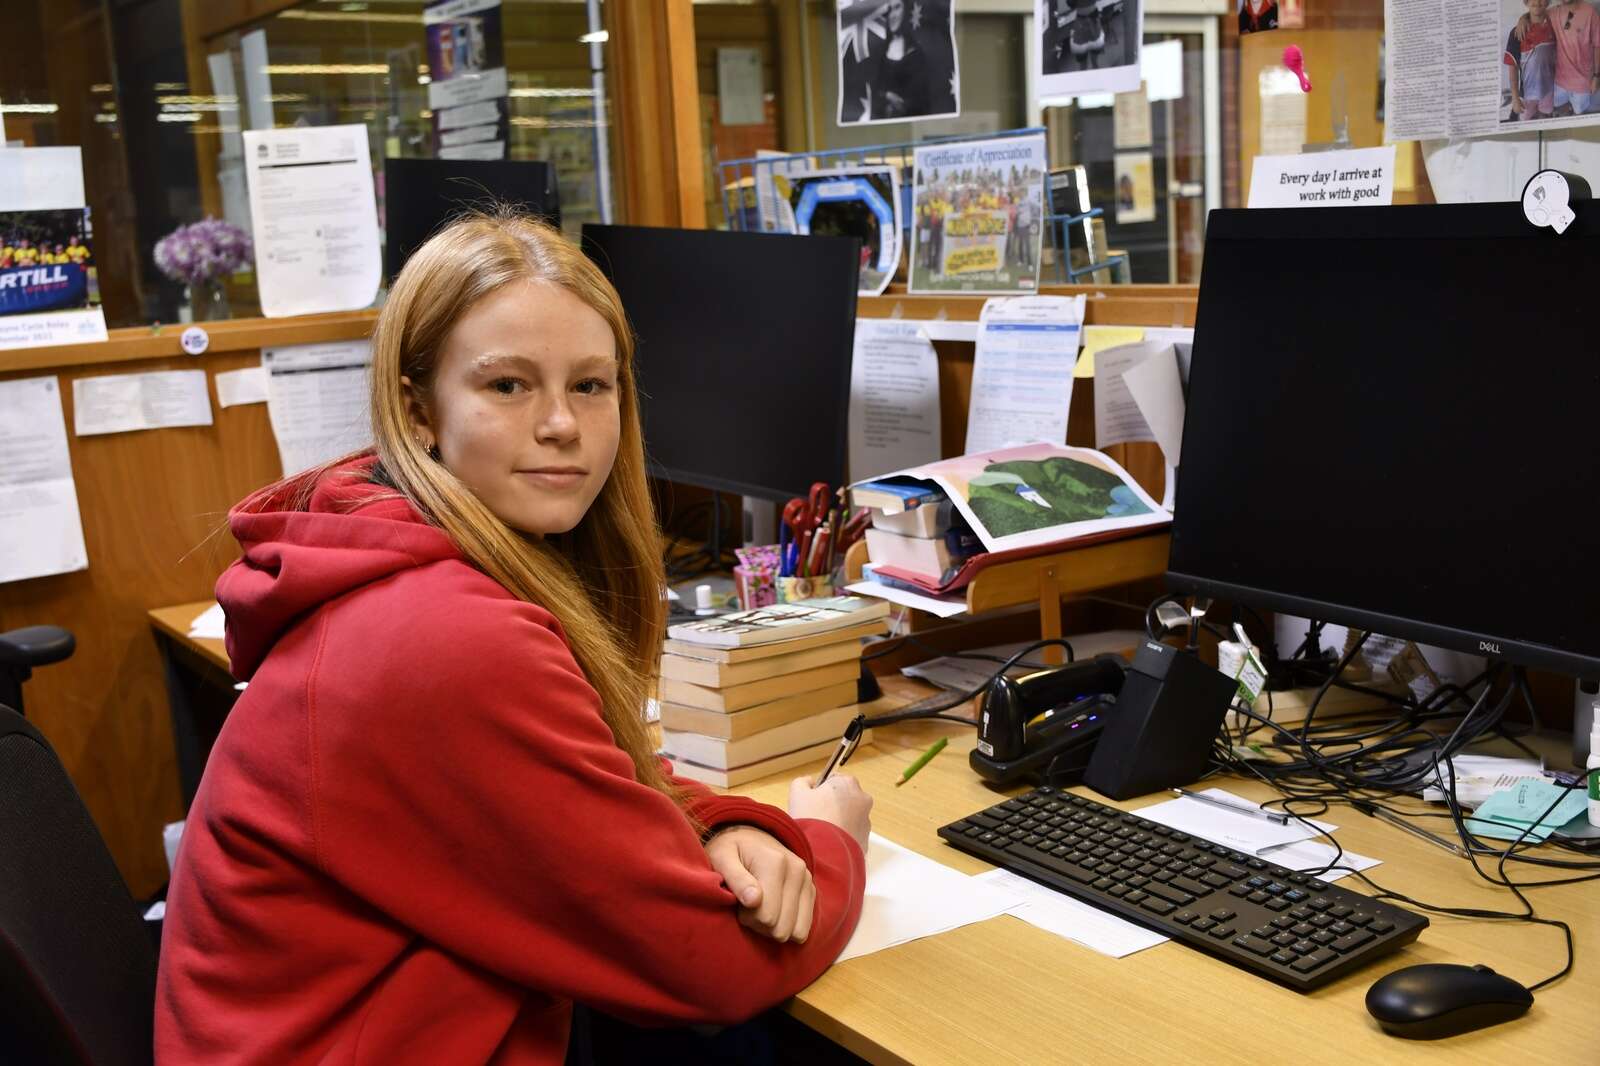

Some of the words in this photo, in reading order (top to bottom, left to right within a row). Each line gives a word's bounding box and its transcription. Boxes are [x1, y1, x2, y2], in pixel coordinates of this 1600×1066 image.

[923, 150, 964, 168] Certificate
[966, 147, 977, 162] of
[978, 146, 1032, 166] Appreciation
[1280, 172, 1310, 187] Every
[1312, 170, 1331, 185] day
[1339, 168, 1370, 181] arrive
[1372, 166, 1382, 179] at
[1299, 188, 1326, 201] work
[1329, 187, 1351, 200] with
[1353, 185, 1380, 201] good
[1480, 641, 1501, 654] DELL
